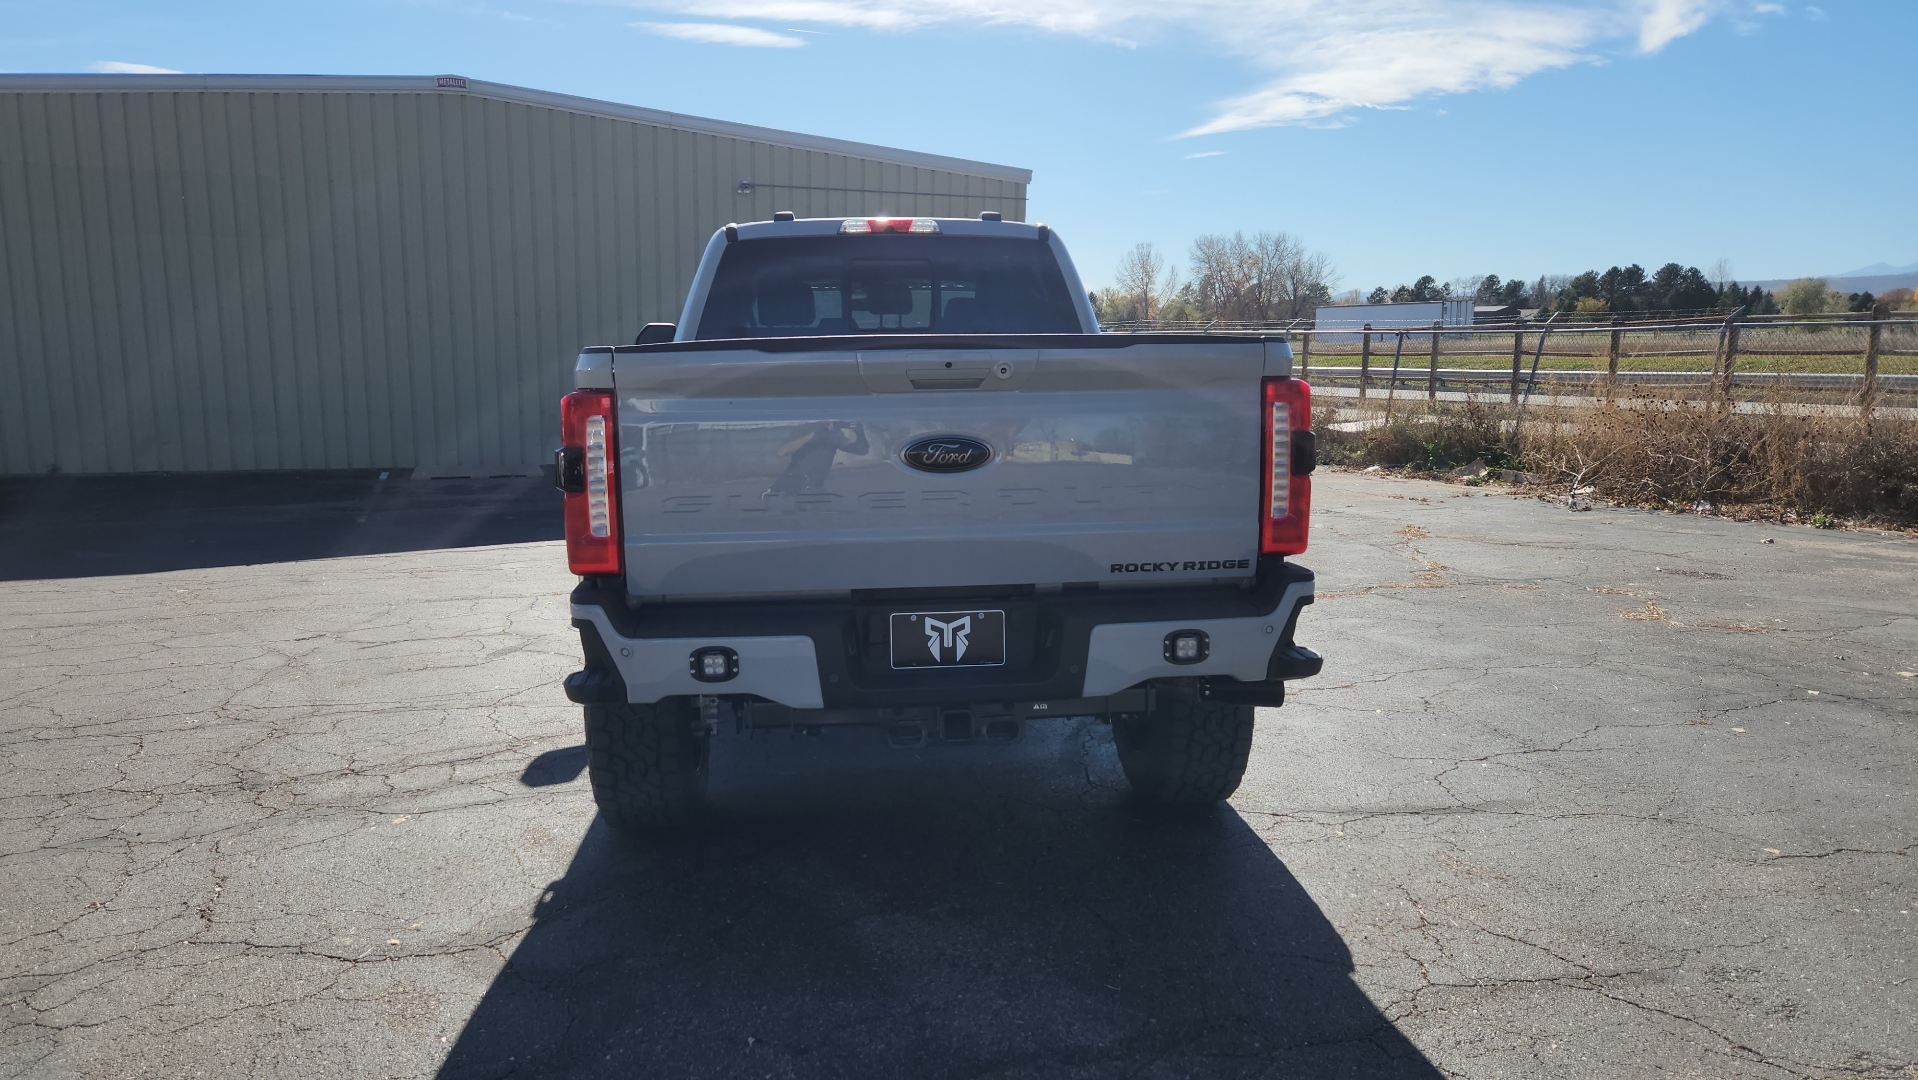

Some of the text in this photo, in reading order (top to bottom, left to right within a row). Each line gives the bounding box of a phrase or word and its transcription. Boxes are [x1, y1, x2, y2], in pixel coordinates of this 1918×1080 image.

[439, 78, 465, 86] METALLIC
[923, 443, 973, 464] Ford
[661, 489, 972, 515] SUPER
[1110, 559, 1250, 573] ROCKY RIDGE
